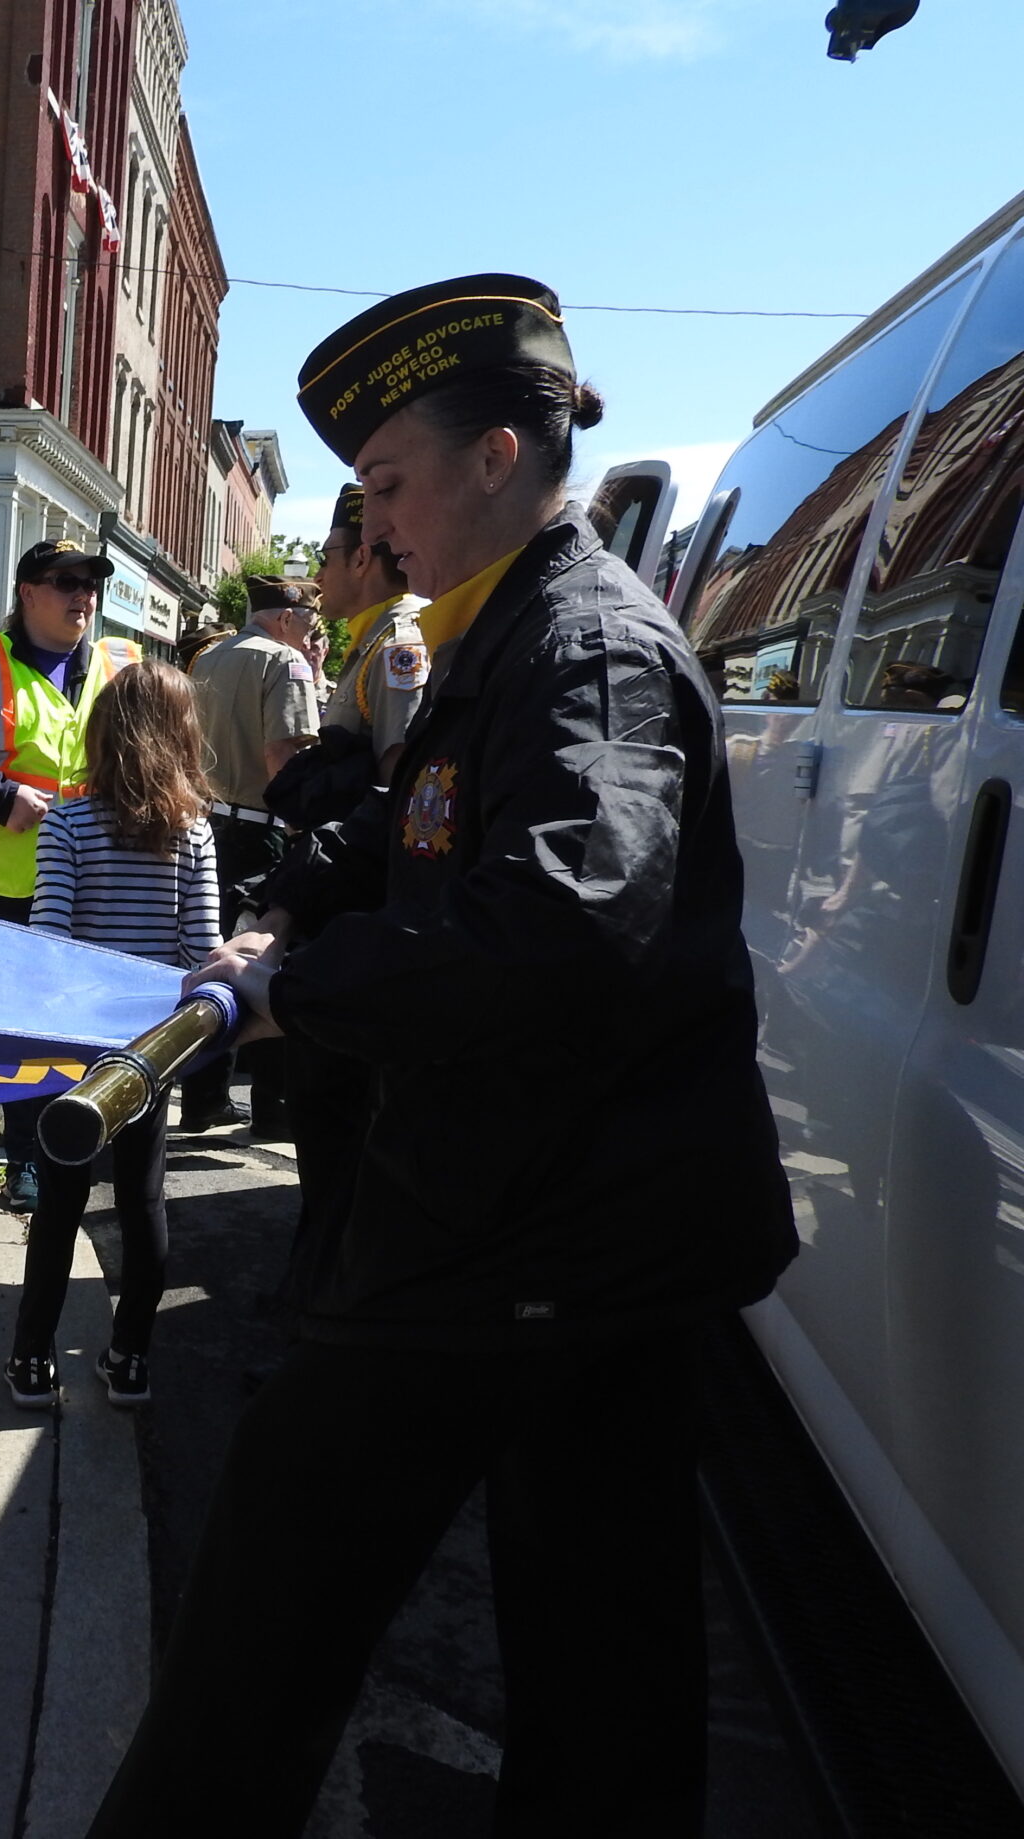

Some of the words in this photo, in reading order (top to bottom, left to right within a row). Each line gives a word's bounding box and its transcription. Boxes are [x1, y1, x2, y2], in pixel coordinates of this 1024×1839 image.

[330, 382, 360, 420] POST
[367, 346, 412, 385] JUDGE
[417, 313, 504, 351] ADVOCATE
[380, 379, 412, 407] NEW
[417, 353, 461, 380] YORK
[386, 346, 443, 386] OWEGO
